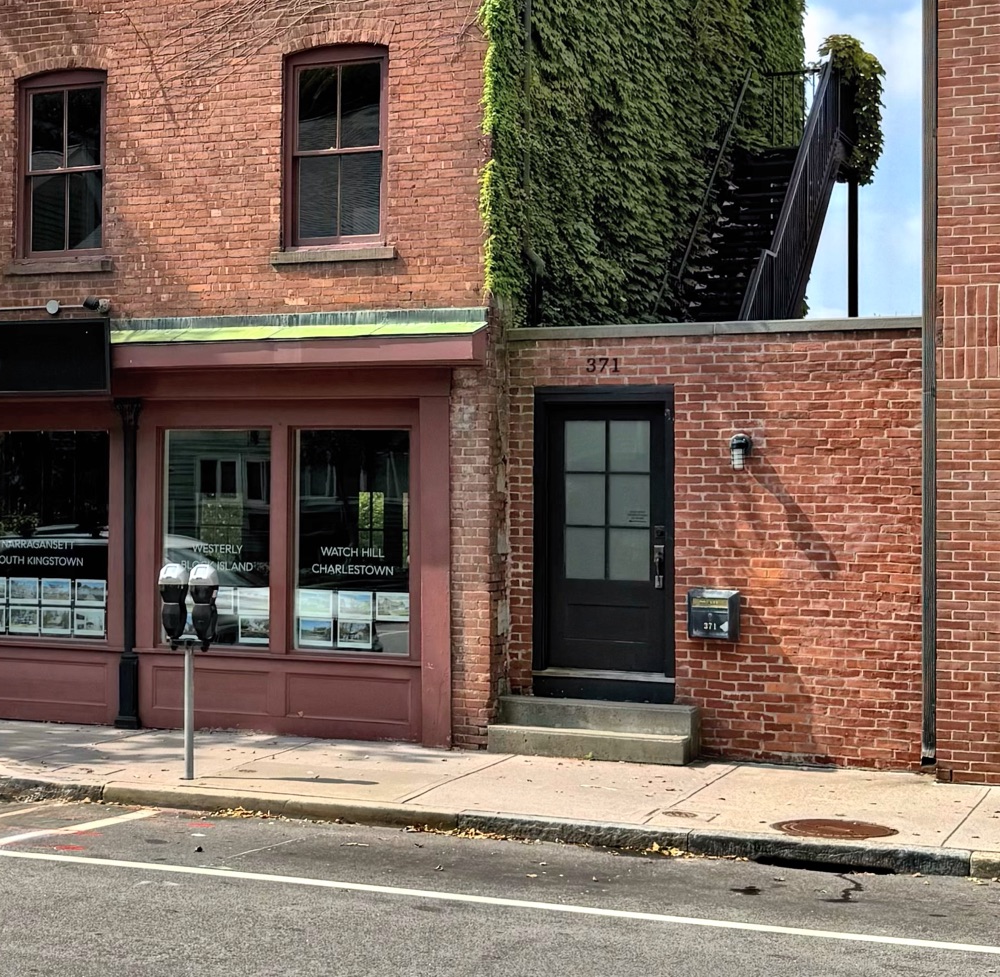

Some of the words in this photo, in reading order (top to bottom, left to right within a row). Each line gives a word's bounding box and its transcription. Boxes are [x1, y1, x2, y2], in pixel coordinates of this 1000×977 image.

[586, 357, 621, 373] 371
[1, 539, 75, 550] NARRAGANSETT
[191, 543, 243, 554] WESTERLY
[320, 546, 358, 558] WATCH
[361, 546, 385, 558] HILL
[27, 555, 84, 567] KINGSTOWN
[217, 561, 254, 572] ISLAND
[311, 563, 394, 576] CHARLESTOWN
[703, 621, 717, 631] 371
